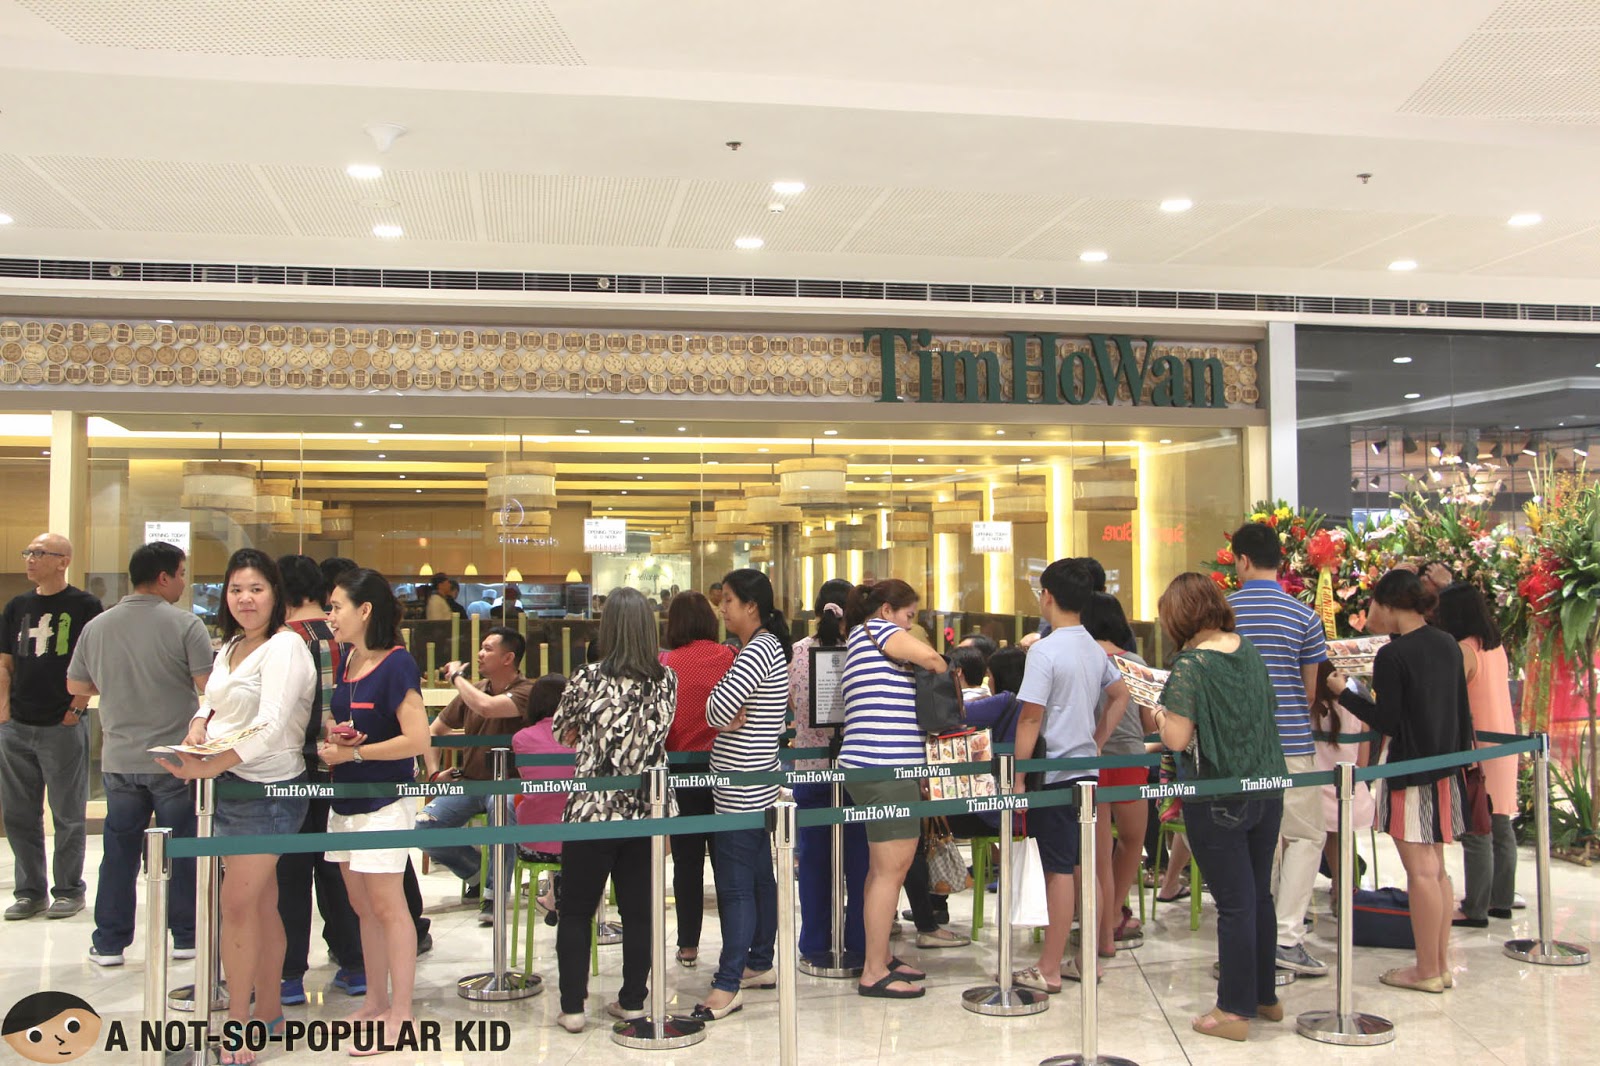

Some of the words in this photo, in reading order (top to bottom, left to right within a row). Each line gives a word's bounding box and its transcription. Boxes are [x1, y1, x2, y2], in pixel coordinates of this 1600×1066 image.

[863, 327, 1228, 408] TimHoWan
[785, 771, 846, 784] TimHoWan
[893, 766, 951, 779] TimHoWan
[520, 780, 587, 794] TimHoWan
[667, 775, 731, 788] TimHoWan
[1240, 776, 1293, 791] TimHoWan
[264, 784, 335, 797] TimHoWan
[396, 783, 464, 796] TimHoWan
[1139, 784, 1196, 799] TimHoWan
[965, 796, 1029, 813] TimHoWan
[842, 805, 911, 822] TimHoWan
